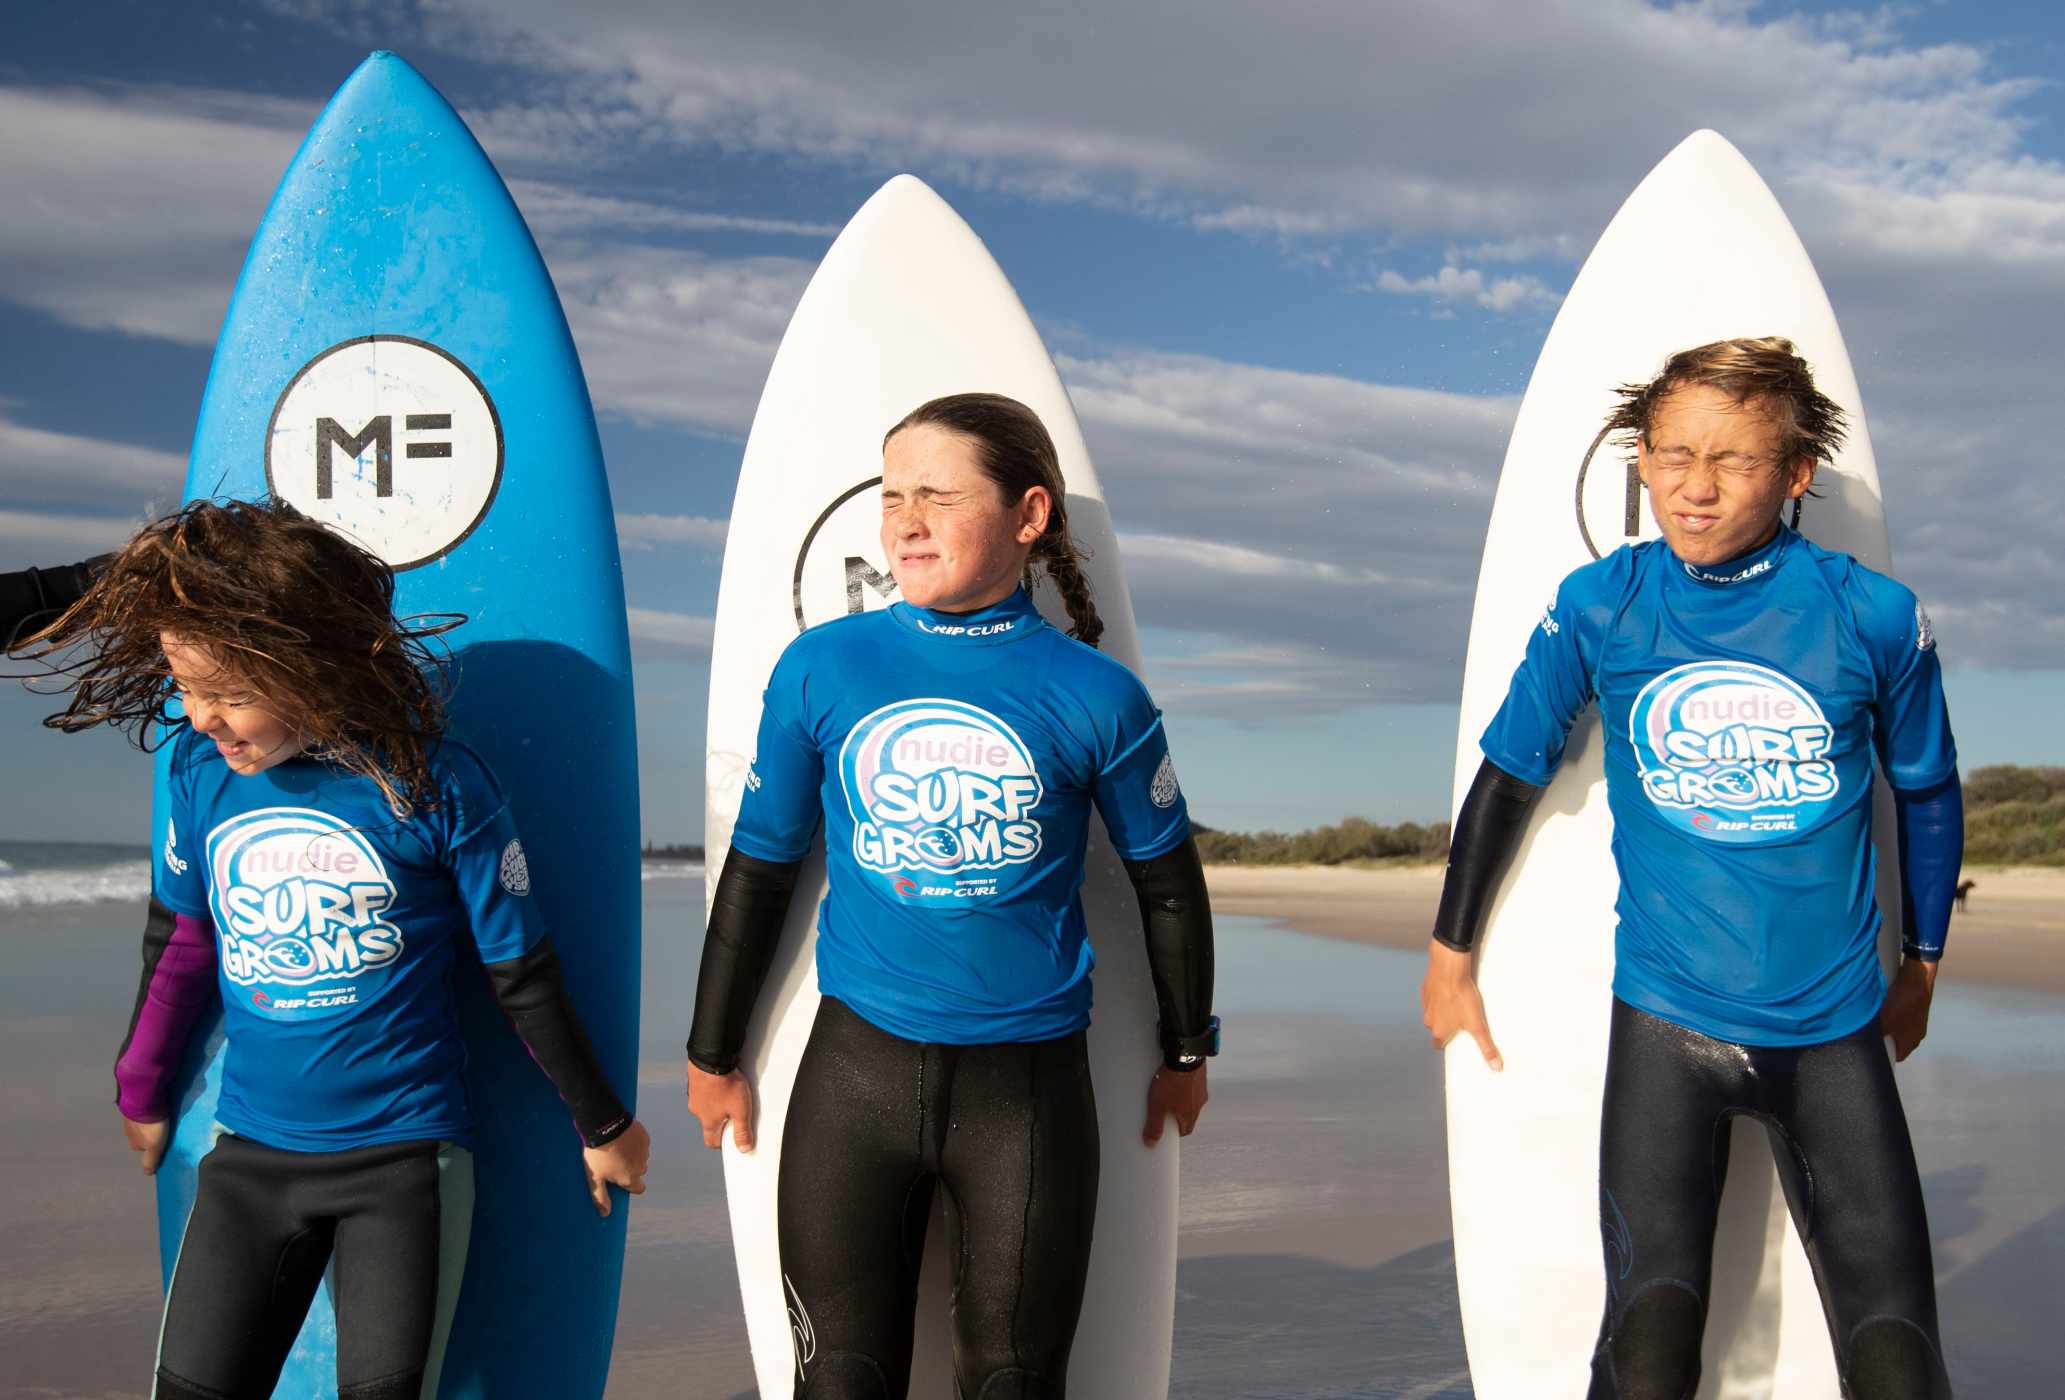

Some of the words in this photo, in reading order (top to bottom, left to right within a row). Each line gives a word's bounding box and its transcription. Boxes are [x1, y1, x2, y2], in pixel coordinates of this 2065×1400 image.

[1731, 560, 1772, 581] CURL
[932, 625, 965, 636] RIP
[966, 620, 1015, 636] CURL
[1688, 694, 1798, 721] nudie
[900, 735, 1010, 768] nudie
[1666, 726, 1828, 769] SURF
[1647, 761, 1833, 803] GROMS
[873, 770, 1037, 827] SURF
[1716, 821, 1750, 831] RIP
[1750, 821, 1798, 831] CURL
[247, 843, 359, 874] nudie
[859, 819, 1036, 867] GROMS
[227, 878, 389, 935] SURF
[920, 886, 953, 896] RIP
[953, 886, 998, 897] CURL
[223, 927, 397, 978] GROMS
[273, 999, 307, 1009] RIP
[306, 994, 359, 1008] CURL
